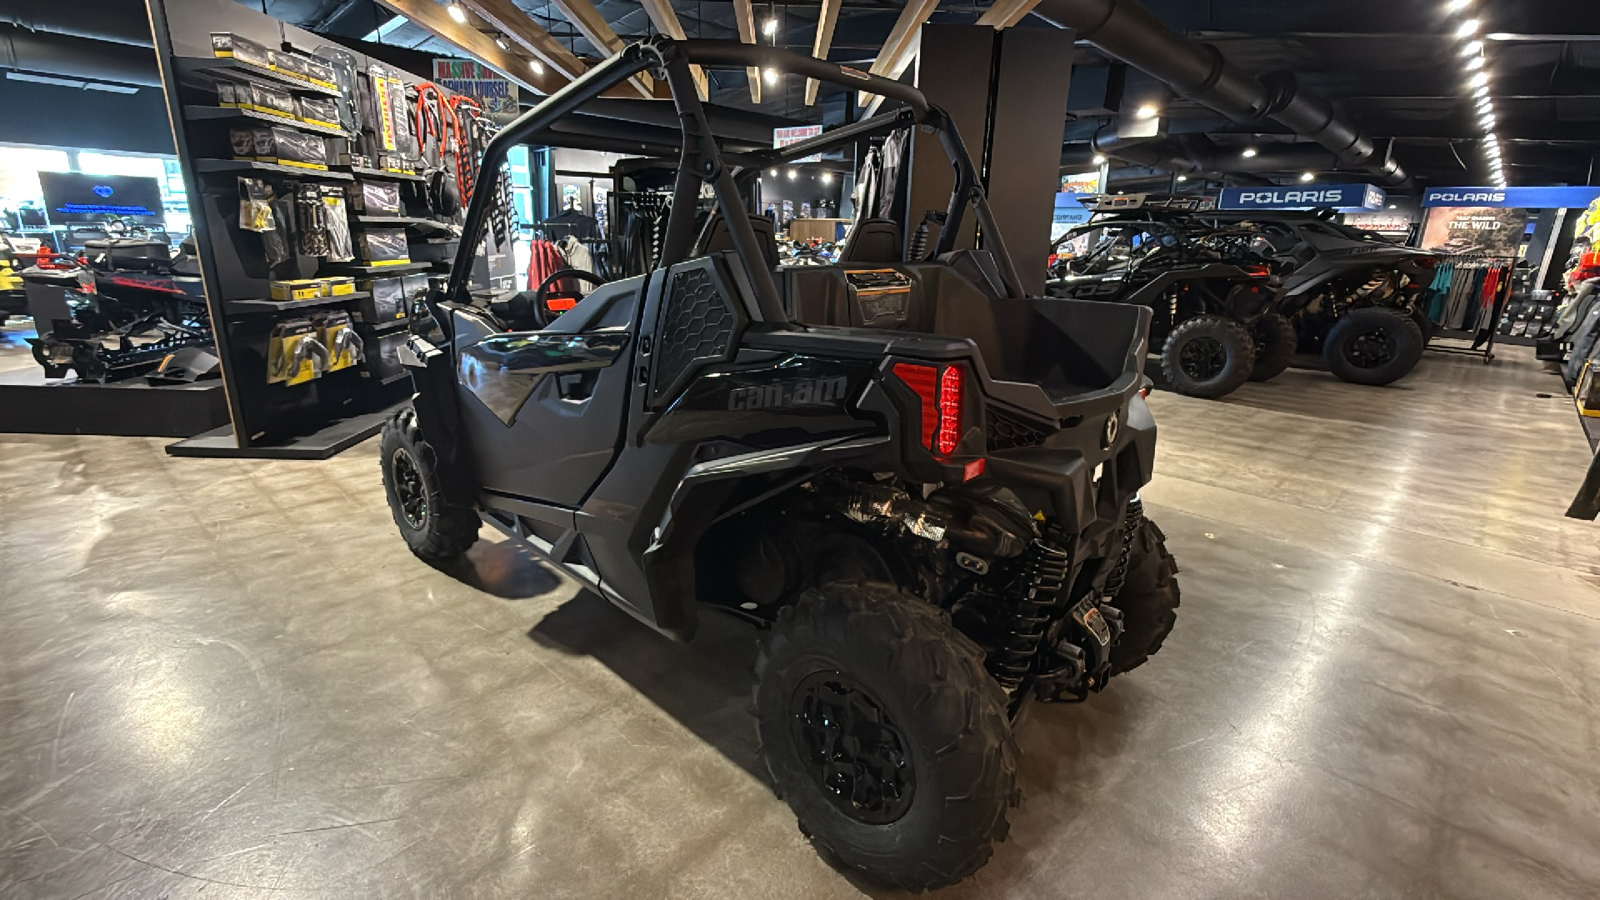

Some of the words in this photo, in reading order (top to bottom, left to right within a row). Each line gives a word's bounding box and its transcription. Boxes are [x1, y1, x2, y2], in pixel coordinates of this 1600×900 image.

[1239, 190, 1342, 204] POLARIS
[1429, 193, 1506, 202] POLARIS
[1448, 221, 1469, 230] THE
[1471, 221, 1501, 230] WILD
[728, 376, 847, 411] can-am
